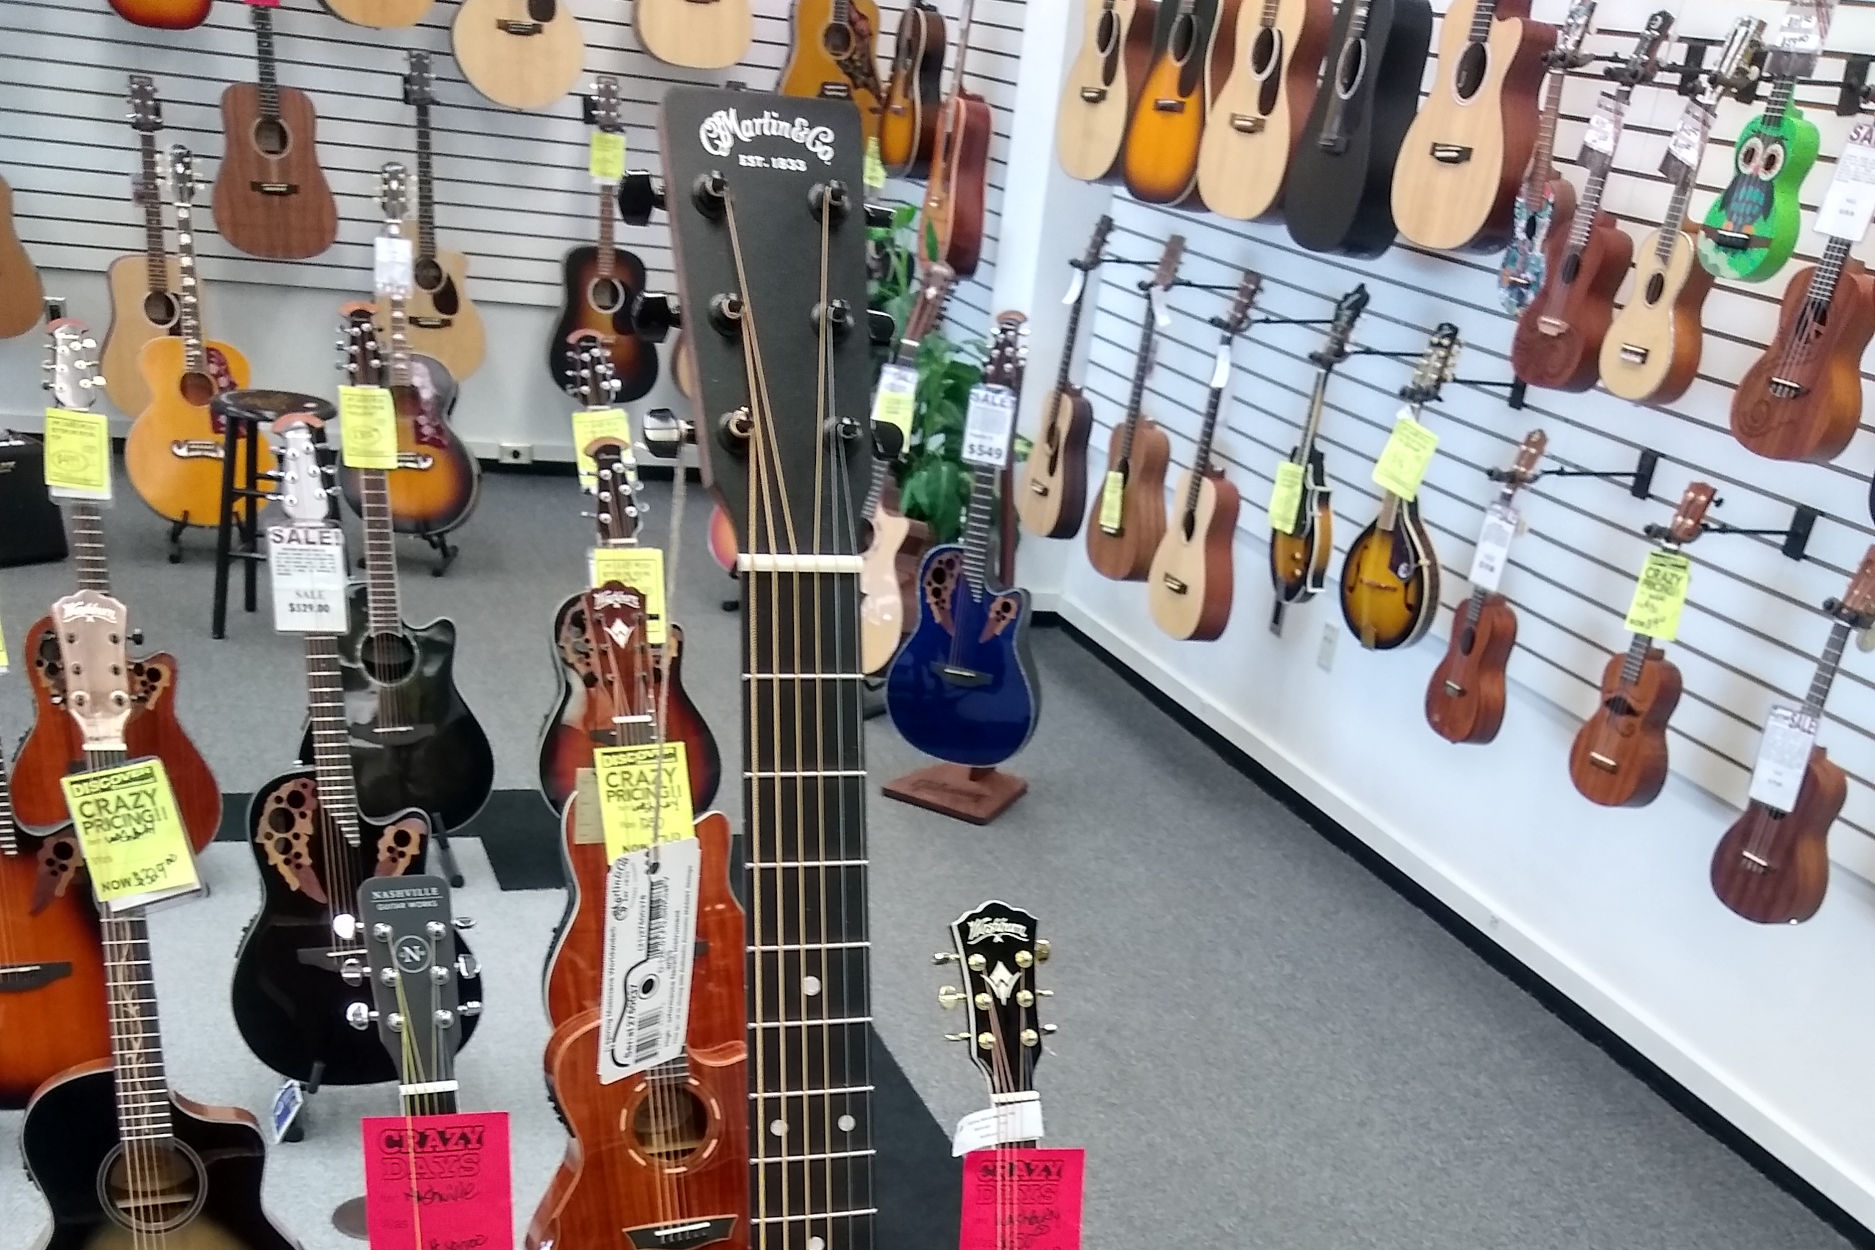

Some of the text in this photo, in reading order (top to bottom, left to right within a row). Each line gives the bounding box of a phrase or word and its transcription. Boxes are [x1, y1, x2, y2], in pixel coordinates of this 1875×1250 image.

[1849, 124, 1875, 146] SA
[968, 444, 1003, 460] $549
[79, 788, 158, 818] CRAZY
[101, 876, 131, 892] NOW
[371, 887, 440, 899] NASHVILLE
[379, 1125, 485, 1154] CRAZY
[381, 1153, 480, 1181] DAYS
